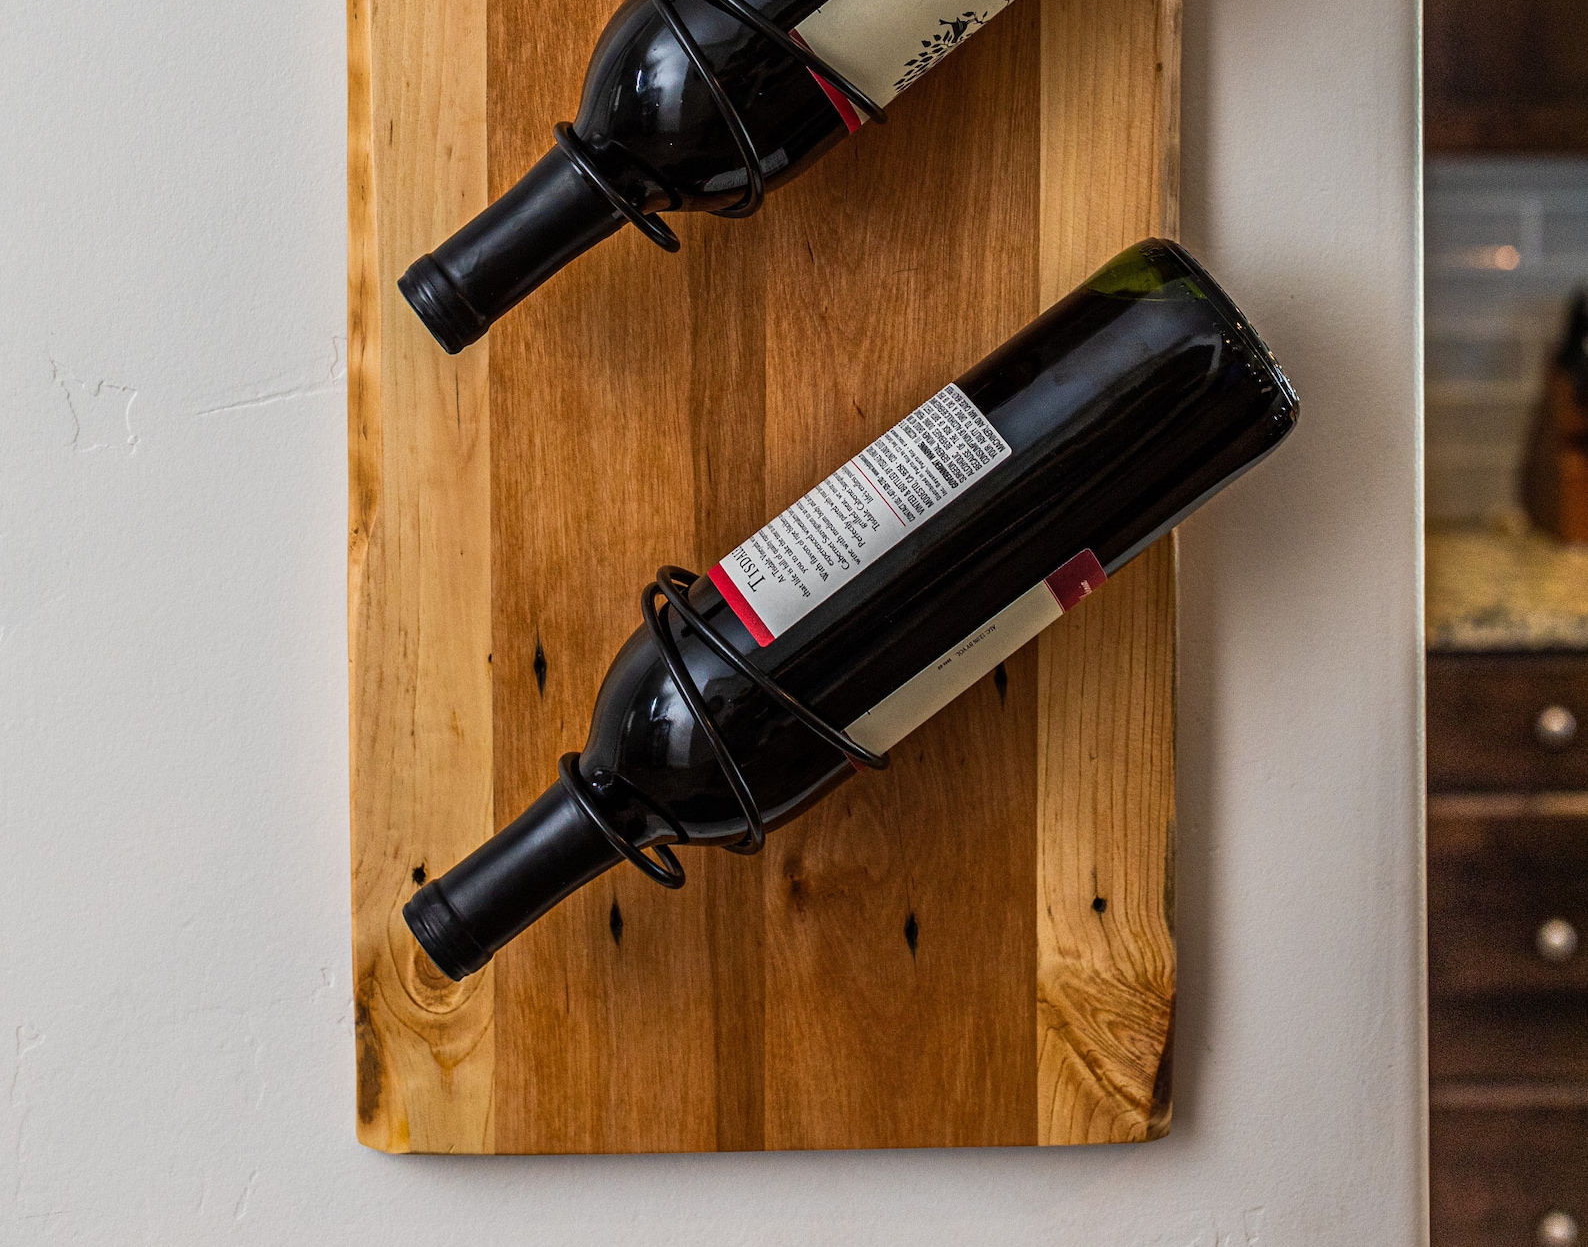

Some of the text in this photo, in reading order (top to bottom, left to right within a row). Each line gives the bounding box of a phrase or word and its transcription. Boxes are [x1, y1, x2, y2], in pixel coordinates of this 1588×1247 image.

[974, 417, 985, 428] AND
[931, 427, 952, 450] BEVERAGES
[949, 433, 959, 444] THE
[970, 427, 986, 445] ABILITY
[982, 425, 1005, 453] MACHINERY,
[962, 432, 990, 465] CONSUMPTION
[984, 443, 998, 459] YOUR
[951, 451, 974, 477] ALCOHOLIC
[962, 448, 982, 471] BECAUSE
[888, 471, 907, 492] BOTTLED
[905, 473, 914, 483] CA
[932, 458, 959, 489] GOVERNMENT
[947, 460, 966, 483] SURGEON
[911, 479, 934, 508] MODESTO,
[921, 476, 941, 501] Distributed
[845, 488, 865, 510] Cabernet
[907, 493, 925, 515] VINTED
[830, 504, 847, 522] paired
[848, 510, 867, 529] grilled
[862, 508, 880, 531] Tisdale
[898, 502, 915, 522] CONTACT
[807, 517, 830, 543] Sauvignon
[821, 515, 839, 536] medium
[843, 520, 866, 547] Perfectly
[777, 537, 785, 547] the
[783, 545, 793, 556] take
[794, 538, 804, 546] of
[806, 533, 834, 566] experienced
[836, 534, 849, 549] with
[778, 558, 789, 570] full
[801, 544, 818, 564] flavors
[826, 541, 850, 570] Cabernet
[847, 548, 861, 565] wine
[764, 557, 786, 583] At Tisdale
[796, 560, 808, 573] you
[814, 562, 829, 581] With
[790, 573, 801, 585] life
[798, 583, 811, 598] that
